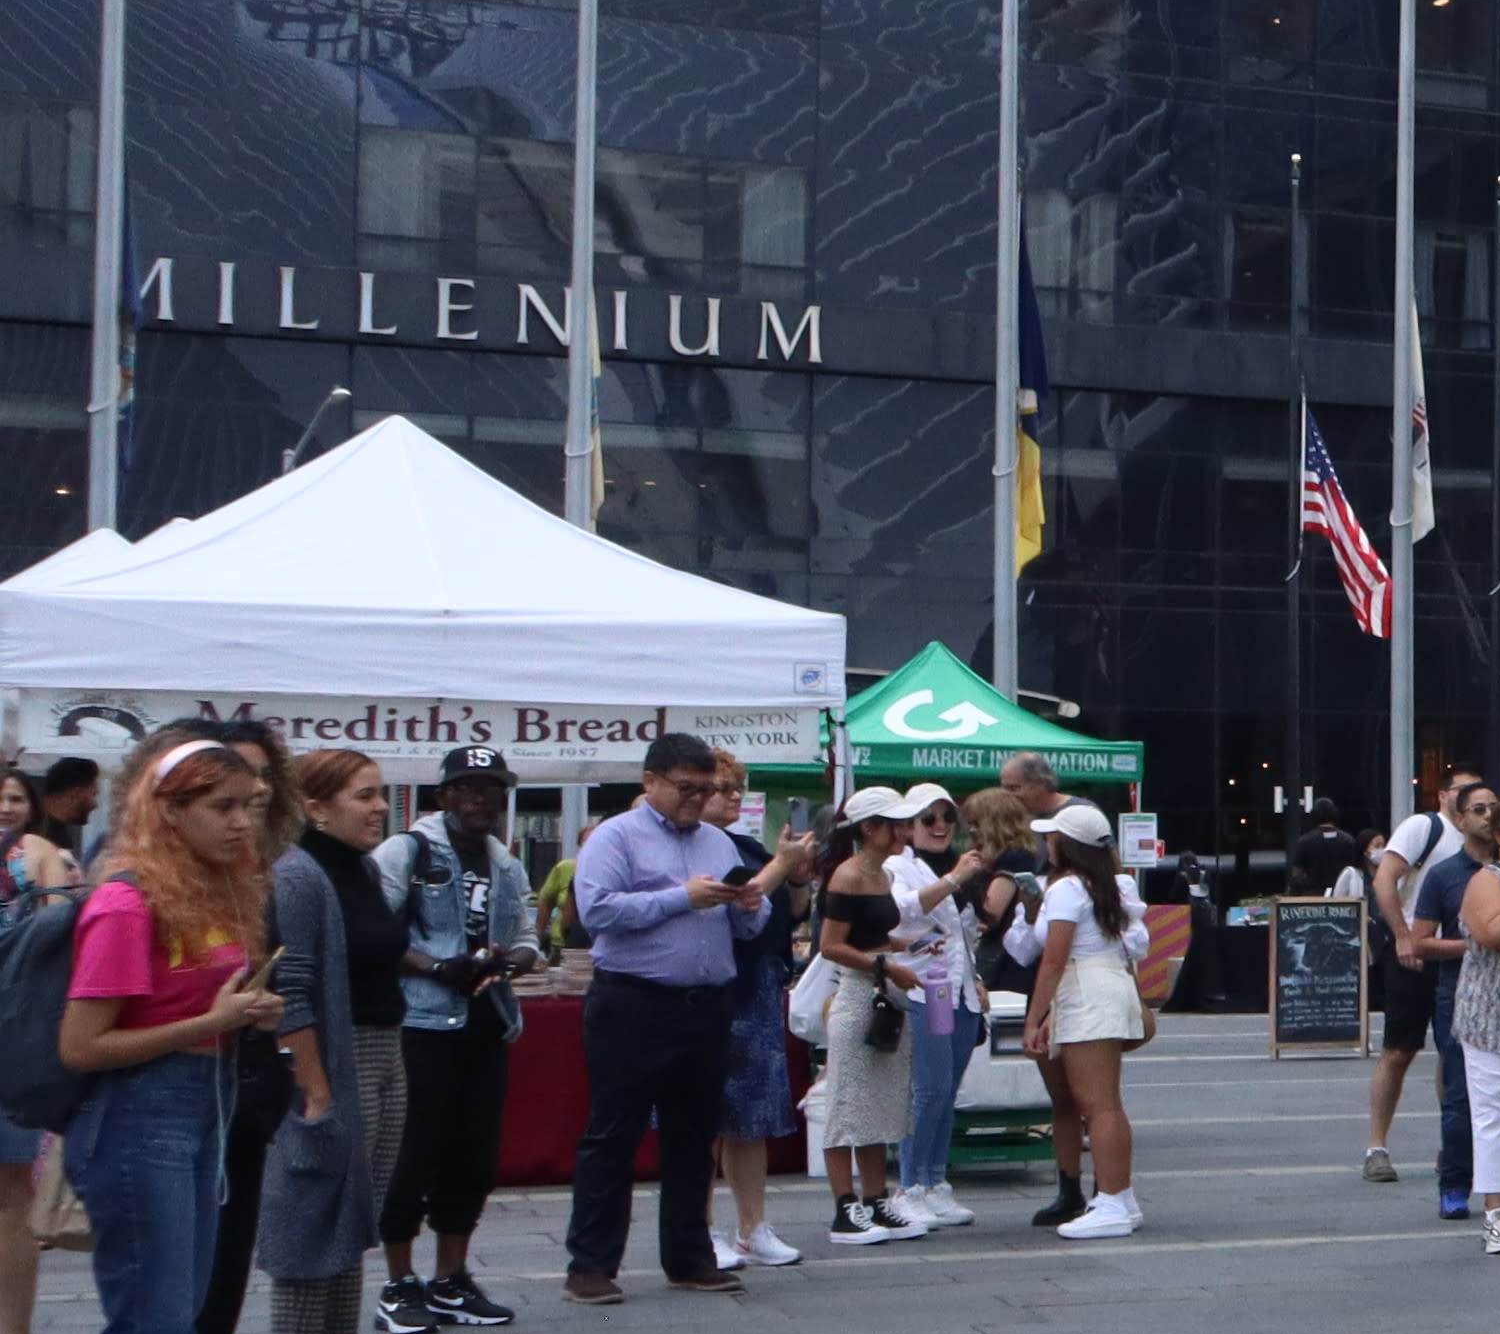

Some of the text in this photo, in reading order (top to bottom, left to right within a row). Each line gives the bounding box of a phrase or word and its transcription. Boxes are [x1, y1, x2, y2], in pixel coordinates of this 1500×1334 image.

[511, 706, 668, 743] Bread
[694, 711, 799, 729] KINGSTON
[747, 731, 799, 746] YORK
[559, 747, 599, 758] 1987
[912, 748, 984, 768] MARKET
[990, 750, 1108, 772] INMATION
